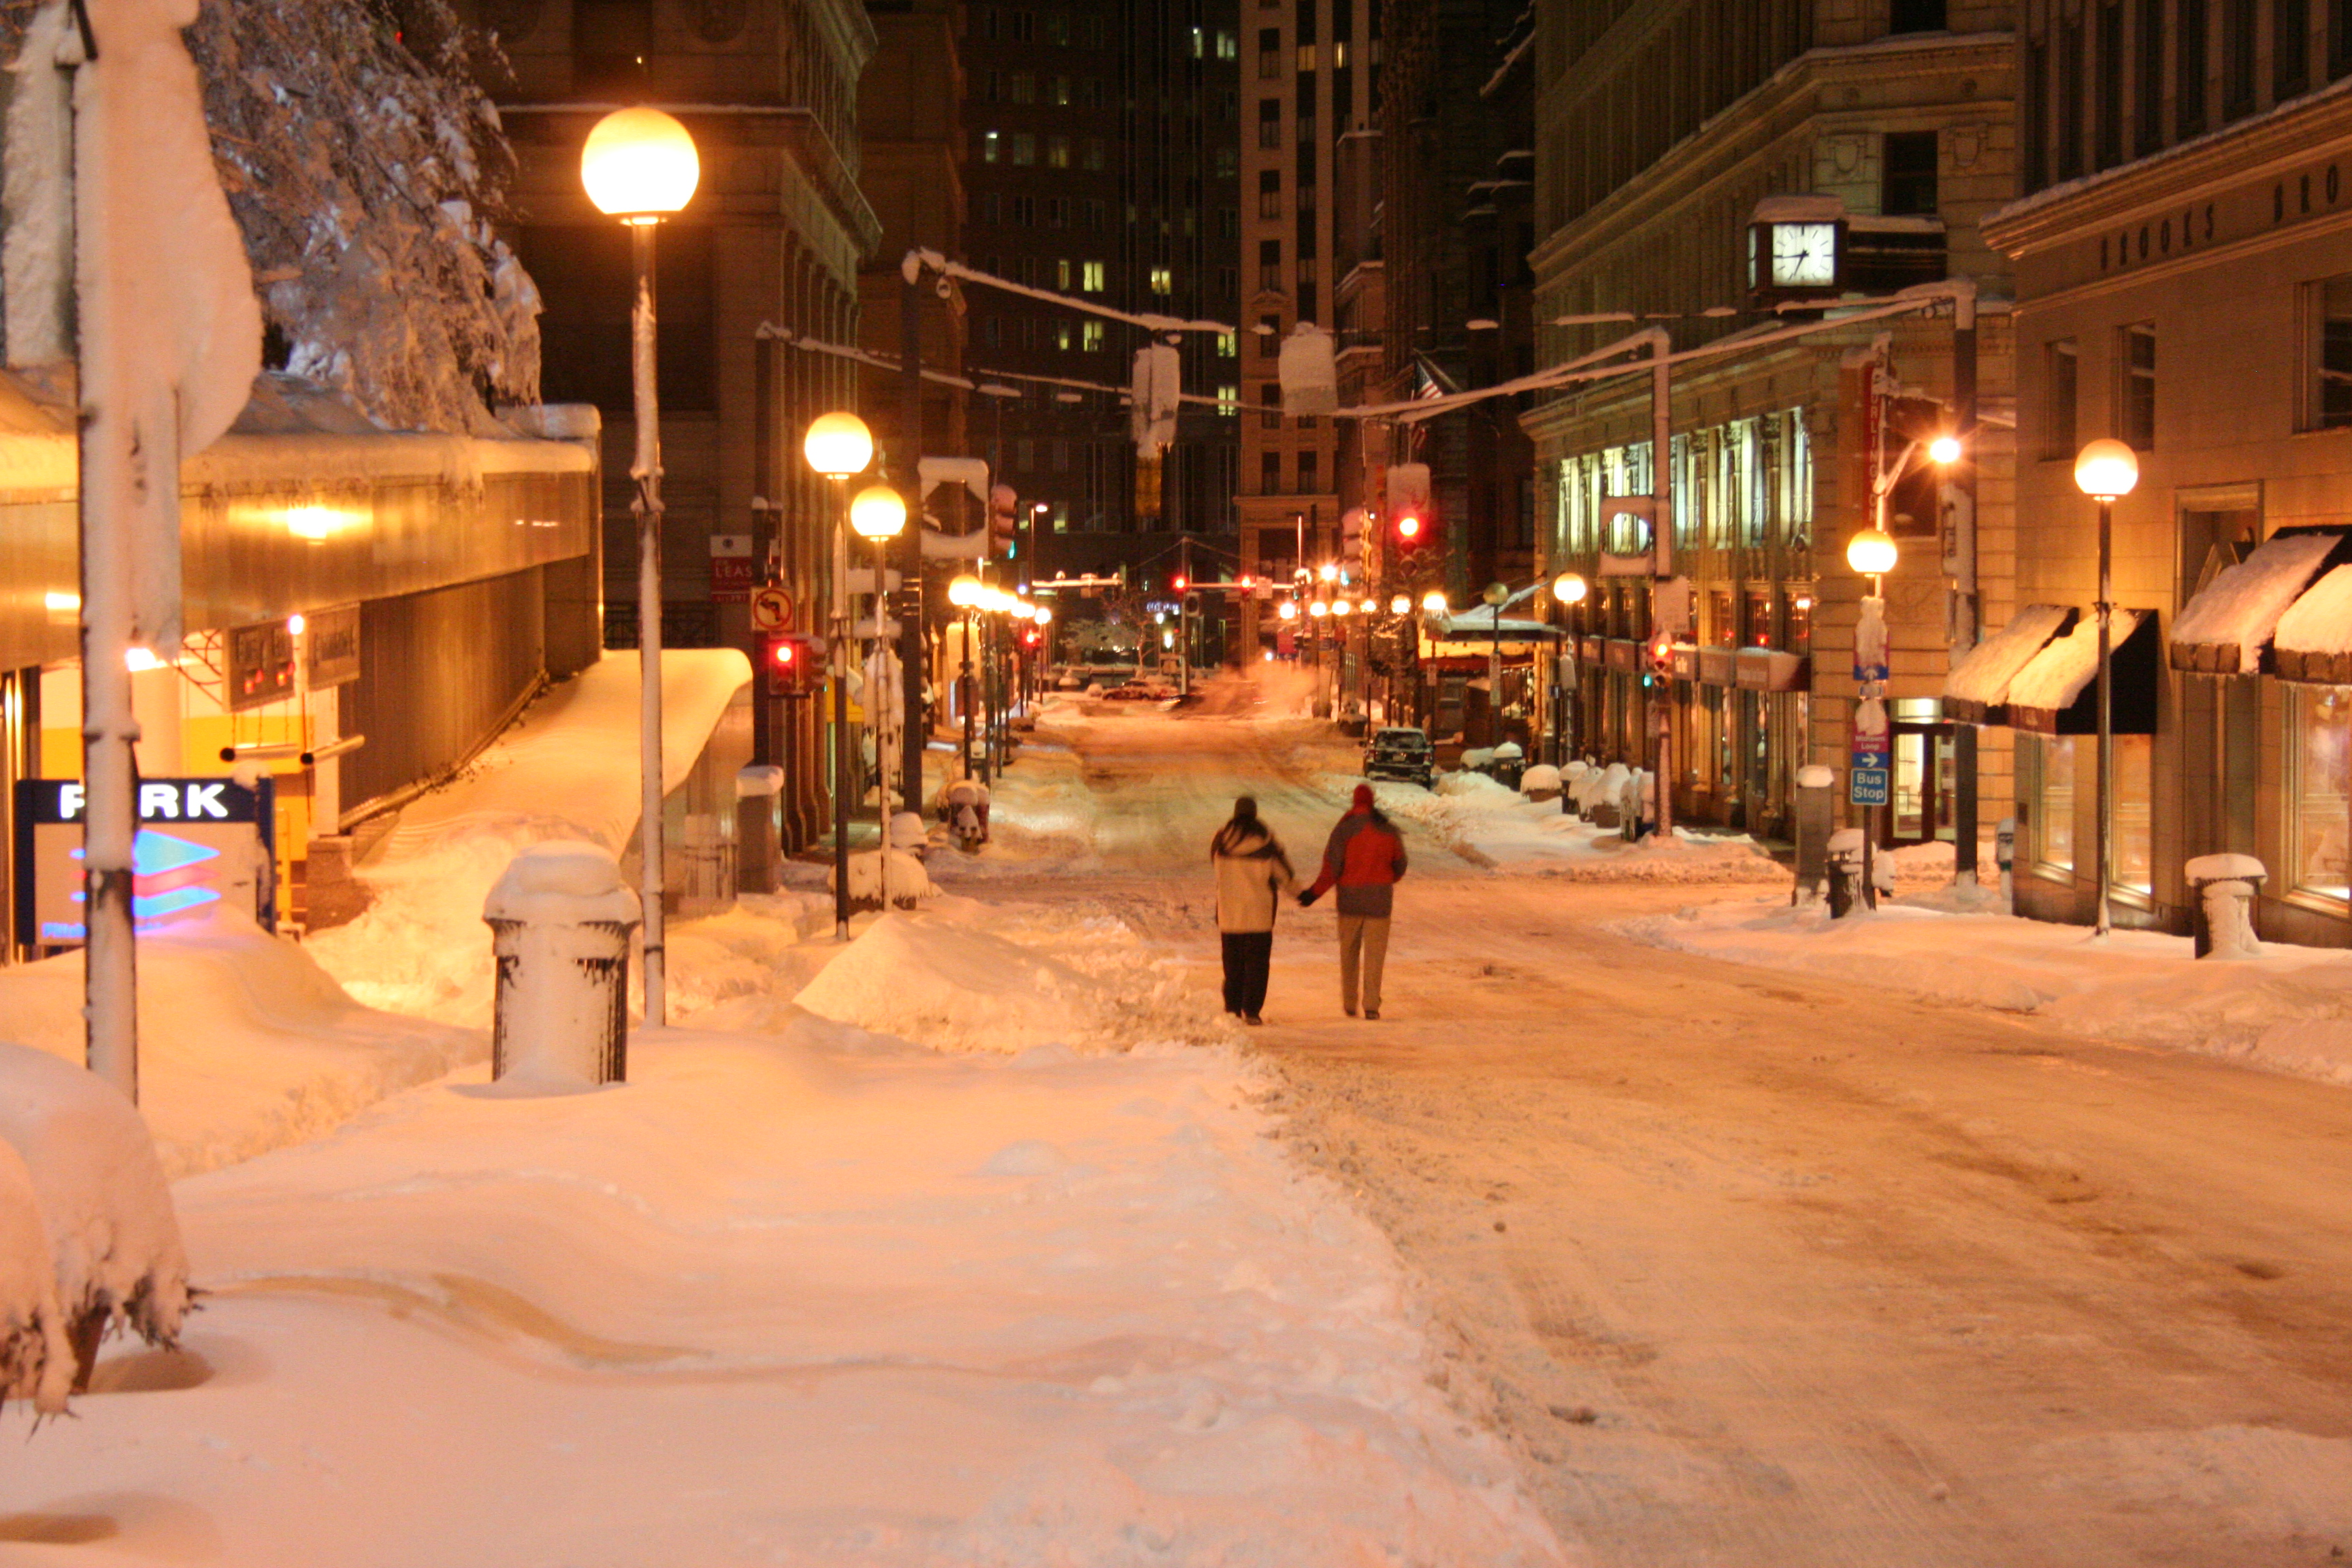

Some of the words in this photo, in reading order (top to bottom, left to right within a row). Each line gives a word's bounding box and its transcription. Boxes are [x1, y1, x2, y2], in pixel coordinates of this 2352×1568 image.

[2100, 202, 2215, 271] BROOKS
[1857, 772, 1882, 785] Bus
[61, 783, 229, 819] PRK
[1854, 786, 1884, 800] Stop
